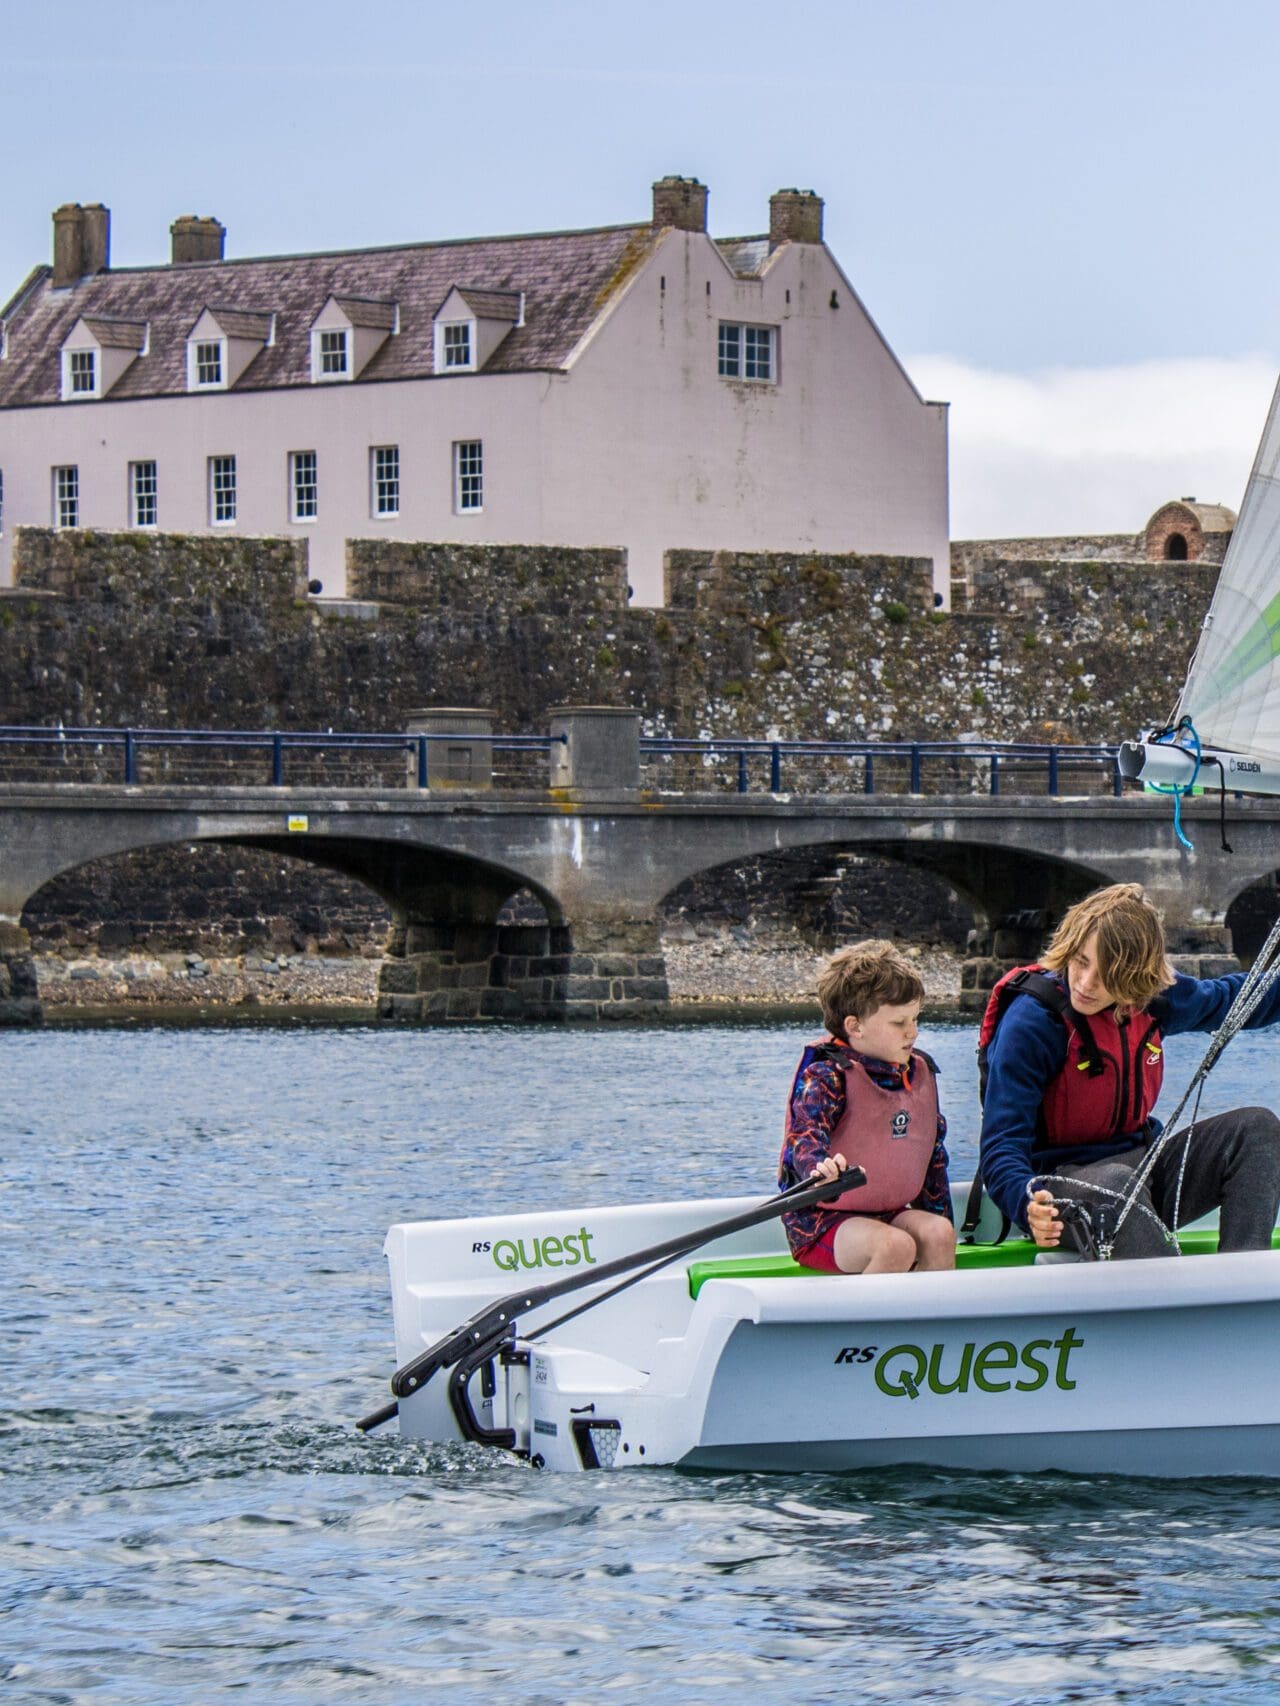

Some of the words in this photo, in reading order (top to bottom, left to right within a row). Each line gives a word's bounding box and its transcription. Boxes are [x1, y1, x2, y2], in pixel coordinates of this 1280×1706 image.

[472, 1241, 491, 1253] RS
[493, 1226, 596, 1272] Quest
[834, 1346, 878, 1364] RS
[874, 1327, 1085, 1400] Quest
